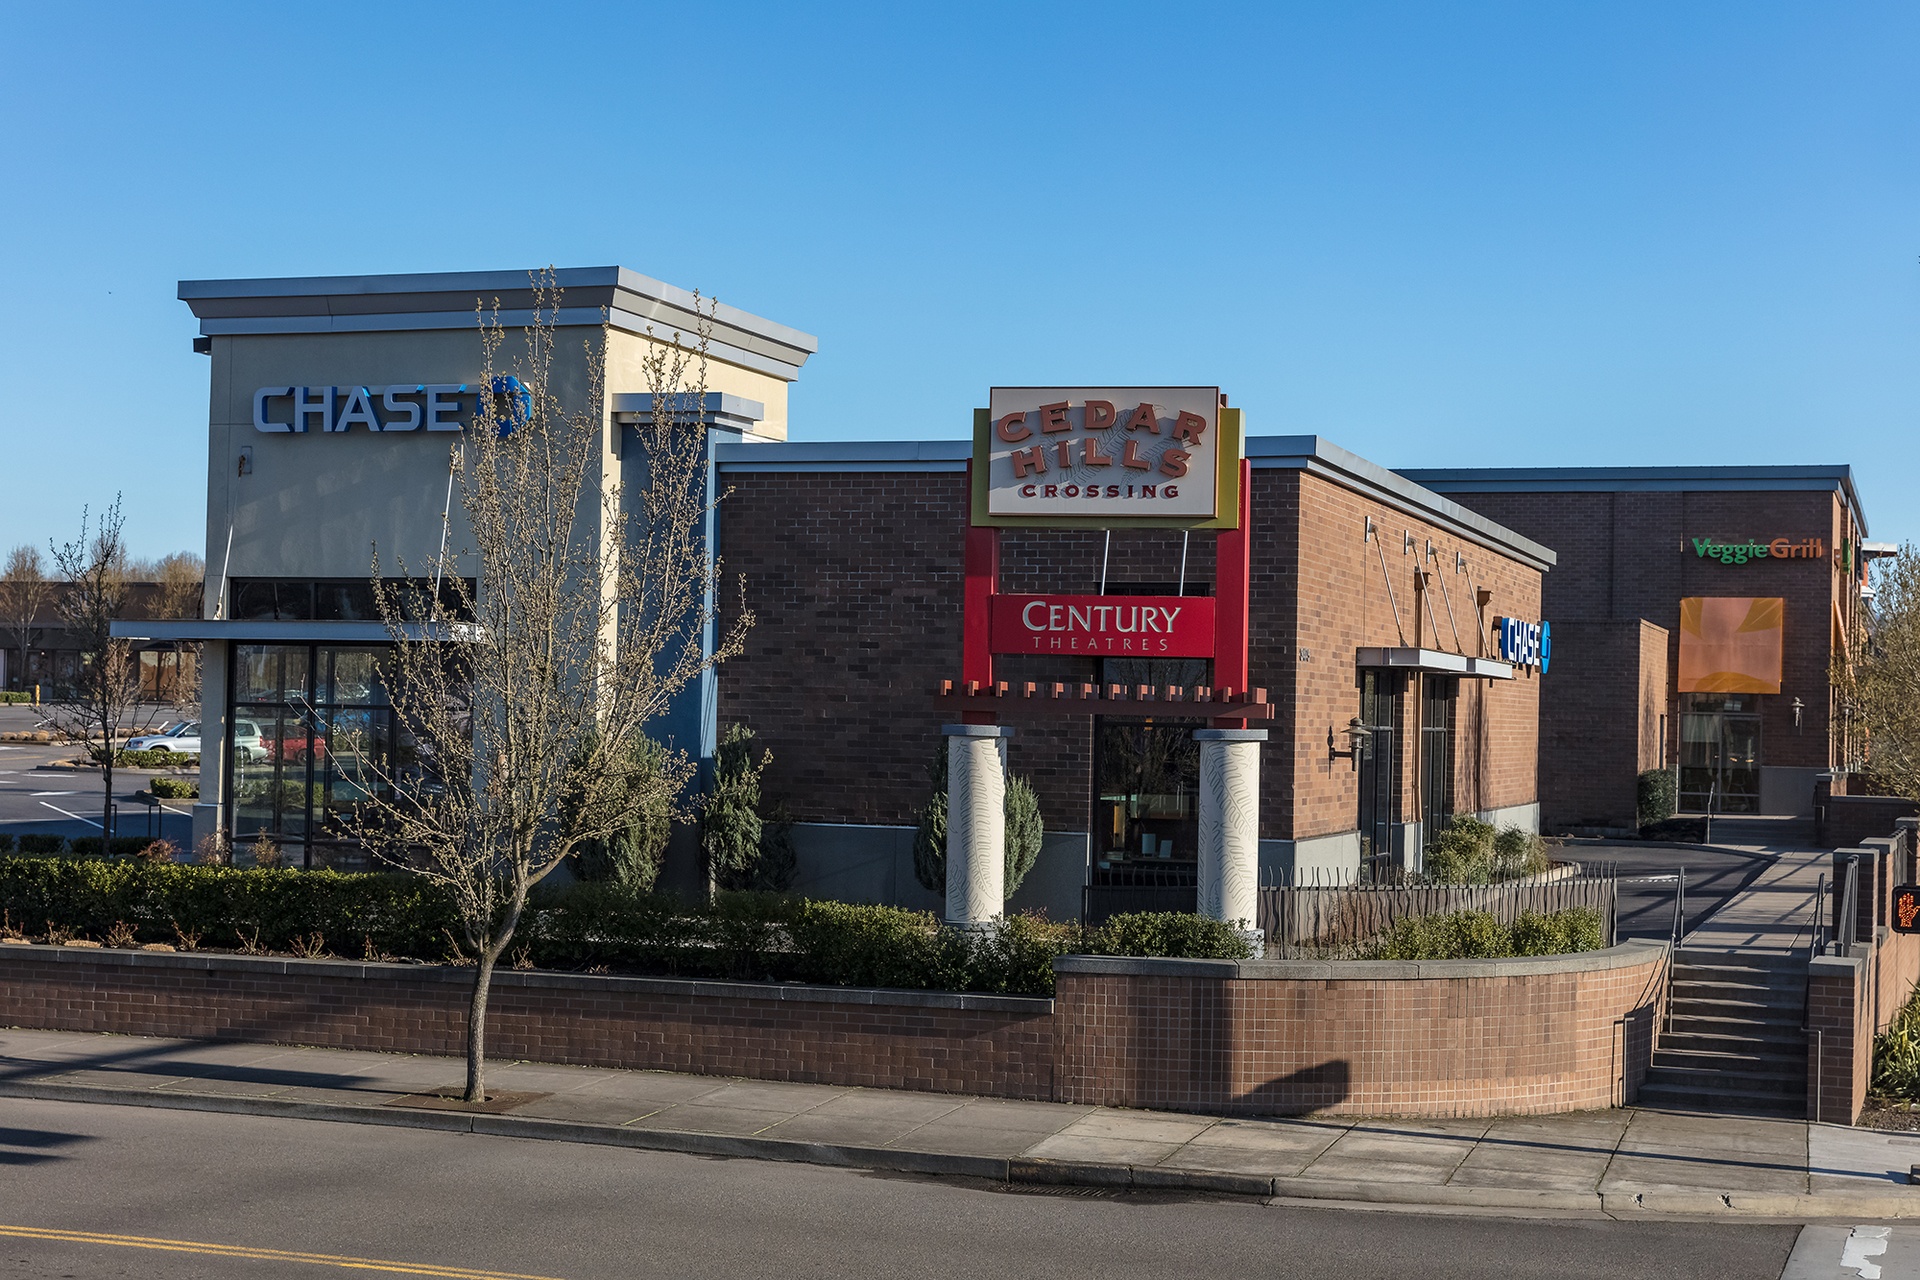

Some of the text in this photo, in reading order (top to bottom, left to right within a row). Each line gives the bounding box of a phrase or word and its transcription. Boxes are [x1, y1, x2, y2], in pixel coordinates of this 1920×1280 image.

[253, 385, 467, 433] CHASE
[997, 400, 1207, 446] CEDAR
[1011, 437, 1192, 479] HILLS
[1022, 484, 1179, 498] CROSSING
[1692, 538, 1824, 565] Veggie Grill
[1033, 637, 1169, 651] THEATRES
[1507, 617, 1541, 666] CHASE
